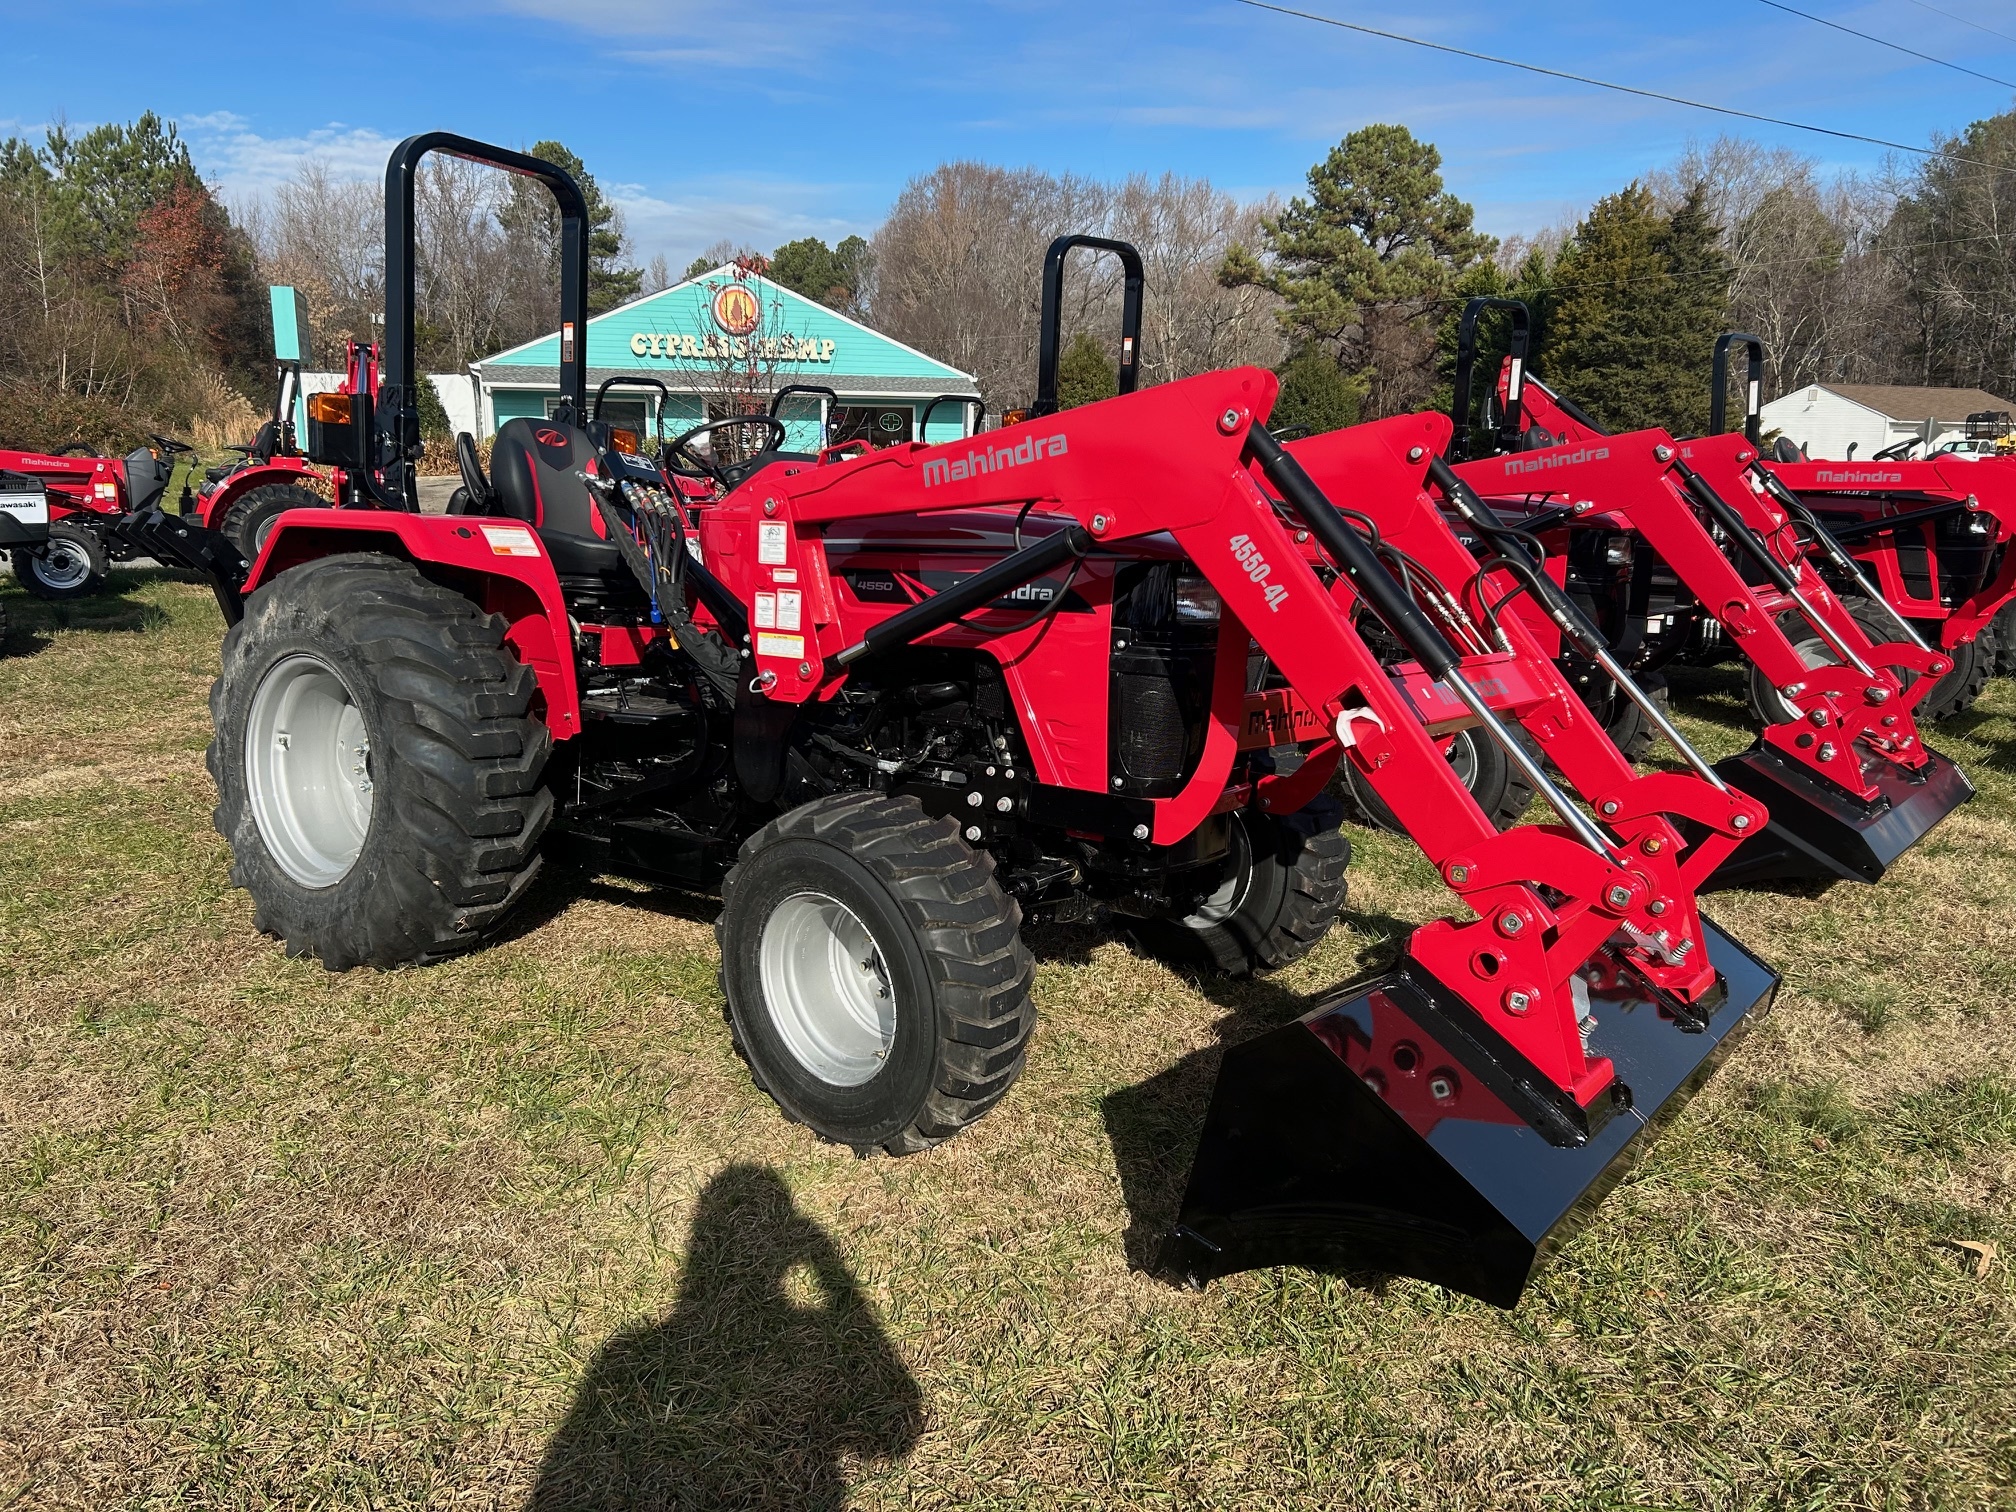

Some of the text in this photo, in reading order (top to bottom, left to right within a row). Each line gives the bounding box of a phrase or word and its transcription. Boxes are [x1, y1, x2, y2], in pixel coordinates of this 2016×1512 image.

[630, 333, 836, 361] CYPRESS HEMP
[21, 457, 70, 467] Mahindra
[922, 433, 1068, 488] Mahindra
[1504, 447, 1610, 476] Mahindra
[1816, 470, 1902, 483] Mahindra
[0, 501, 36, 509] awasaki
[1229, 534, 1290, 613] 4550-4L
[857, 581, 894, 591] 4550
